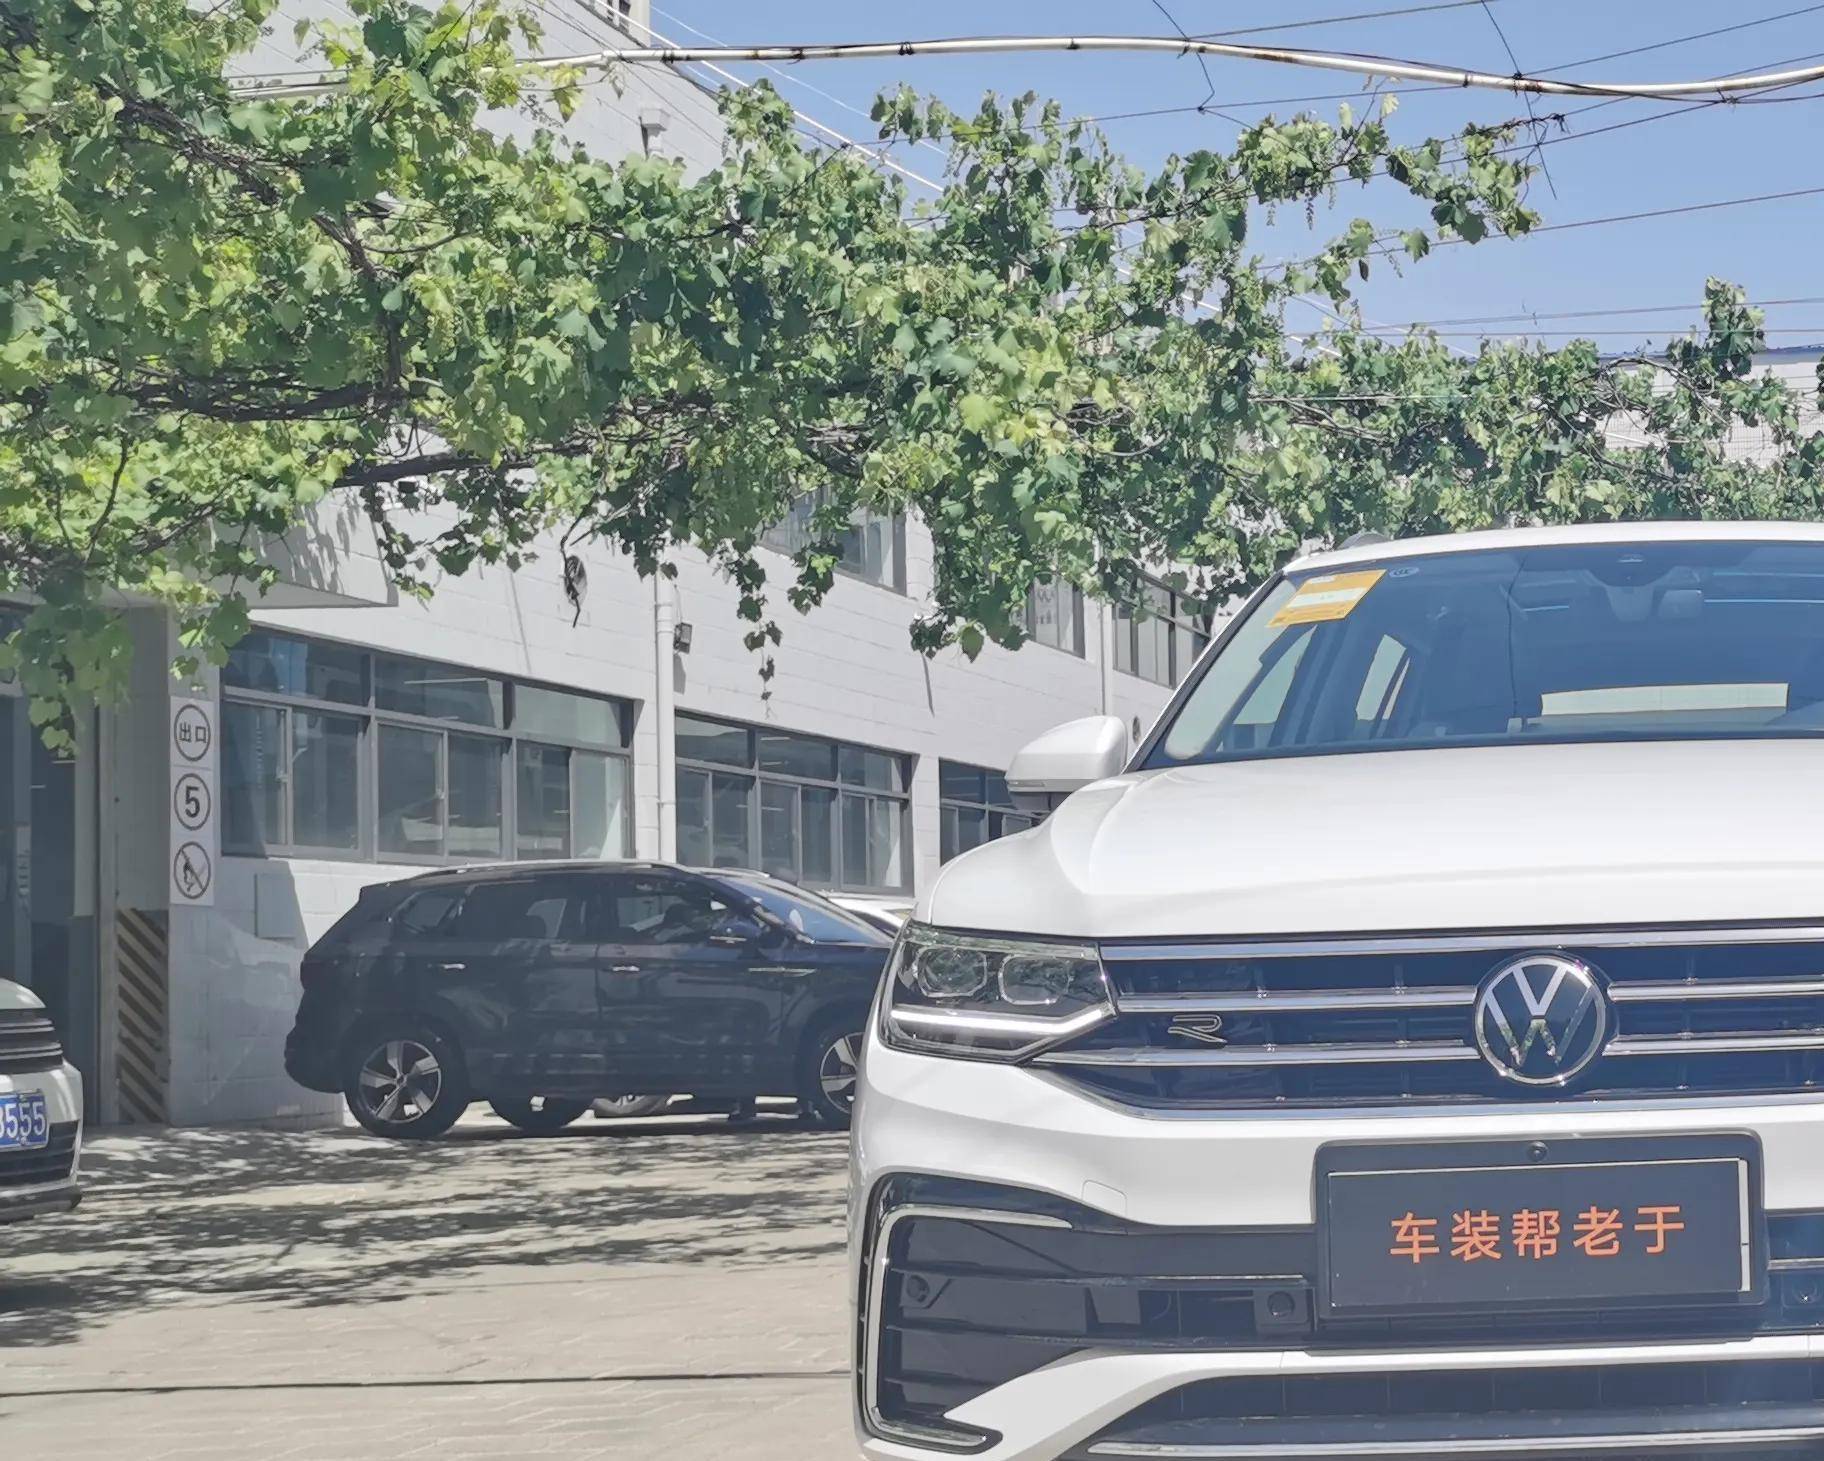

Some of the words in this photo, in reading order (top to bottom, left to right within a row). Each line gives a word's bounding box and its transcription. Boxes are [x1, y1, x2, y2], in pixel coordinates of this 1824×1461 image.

[179, 721, 207, 743] 出口
[185, 785, 200, 818] 5
[1480, 961, 1600, 1072] VW
[1390, 1205, 1685, 1264] 车装帮老于
